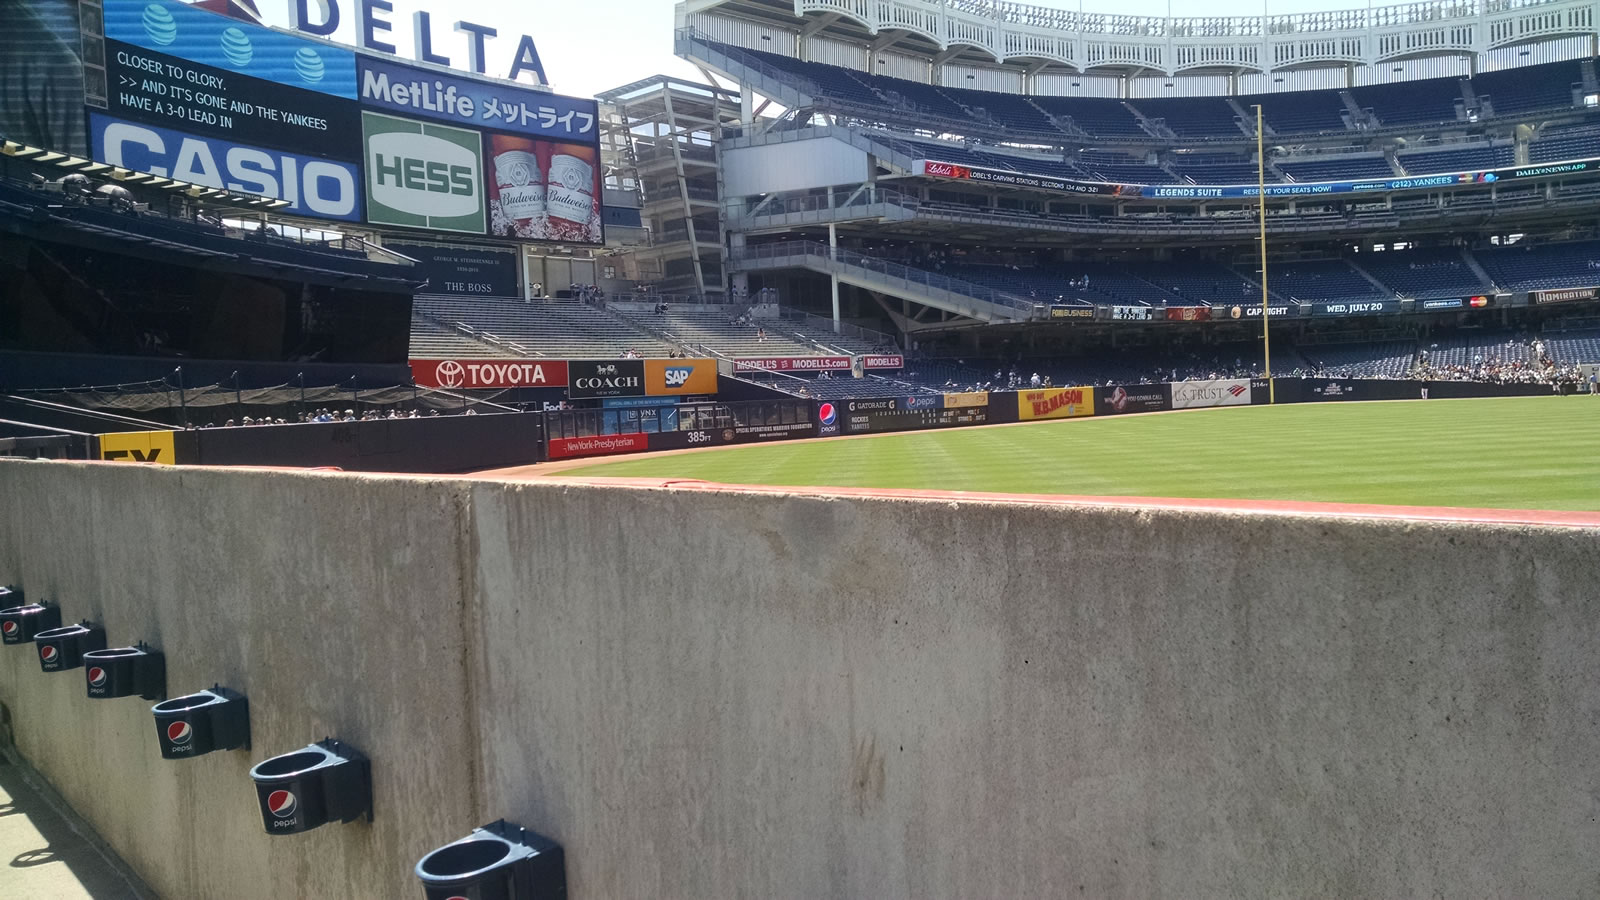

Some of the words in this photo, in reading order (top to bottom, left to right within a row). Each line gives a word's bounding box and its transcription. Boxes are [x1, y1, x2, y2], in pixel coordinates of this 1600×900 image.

[288, 0, 549, 86] DELTA
[117, 52, 163, 75] CLOSER
[166, 65, 183, 79] TO
[186, 70, 227, 91] GLORY.
[362, 70, 475, 117] MetLife
[120, 93, 151, 111] HAVE
[155, 103, 163, 114] A
[167, 104, 185, 118] 3-0
[188, 109, 216, 125] LEAD
[220, 116, 233, 128] IN
[141, 79, 167, 96] AND
[170, 86, 192, 101] IT'S
[195, 91, 227, 110] GONE
[230, 101, 253, 115] AND
[255, 106, 278, 121] THE
[280, 111, 327, 131] YANKEES
[483, 98, 594, 133] メットライフ
[104, 123, 355, 216] CASIO
[376, 153, 473, 197] HESS
[1516, 168, 1541, 177] DAILY
[1545, 165, 1571, 174] NEWS
[1392, 180, 1412, 188] (212)
[1413, 176, 1452, 186] YANKEES
[1155, 188, 1195, 196] LEGENDS
[1197, 188, 1222, 196] SUITE
[445, 281, 465, 292] THE
[468, 282, 492, 293] BOSS
[1246, 308, 1262, 316] CAP
[1349, 304, 1370, 314] JULY
[1370, 302, 1383, 310] 20
[737, 360, 777, 370] MODELL'S
[792, 360, 848, 370] MODELLS.com
[867, 358, 900, 366] MODELL'S
[468, 364, 546, 384] TOYOTA
[665, 370, 689, 386] SAP
[576, 376, 638, 389] COACH
[1174, 390, 1188, 402] U.S.
[1190, 388, 1224, 400] TRUST
[848, 402, 856, 411] G
[888, 400, 895, 409] G
[916, 396, 936, 408] pepsi
[820, 426, 836, 434] pepsi
[172, 744, 192, 753] pepsi
[274, 817, 297, 828] pepsi
